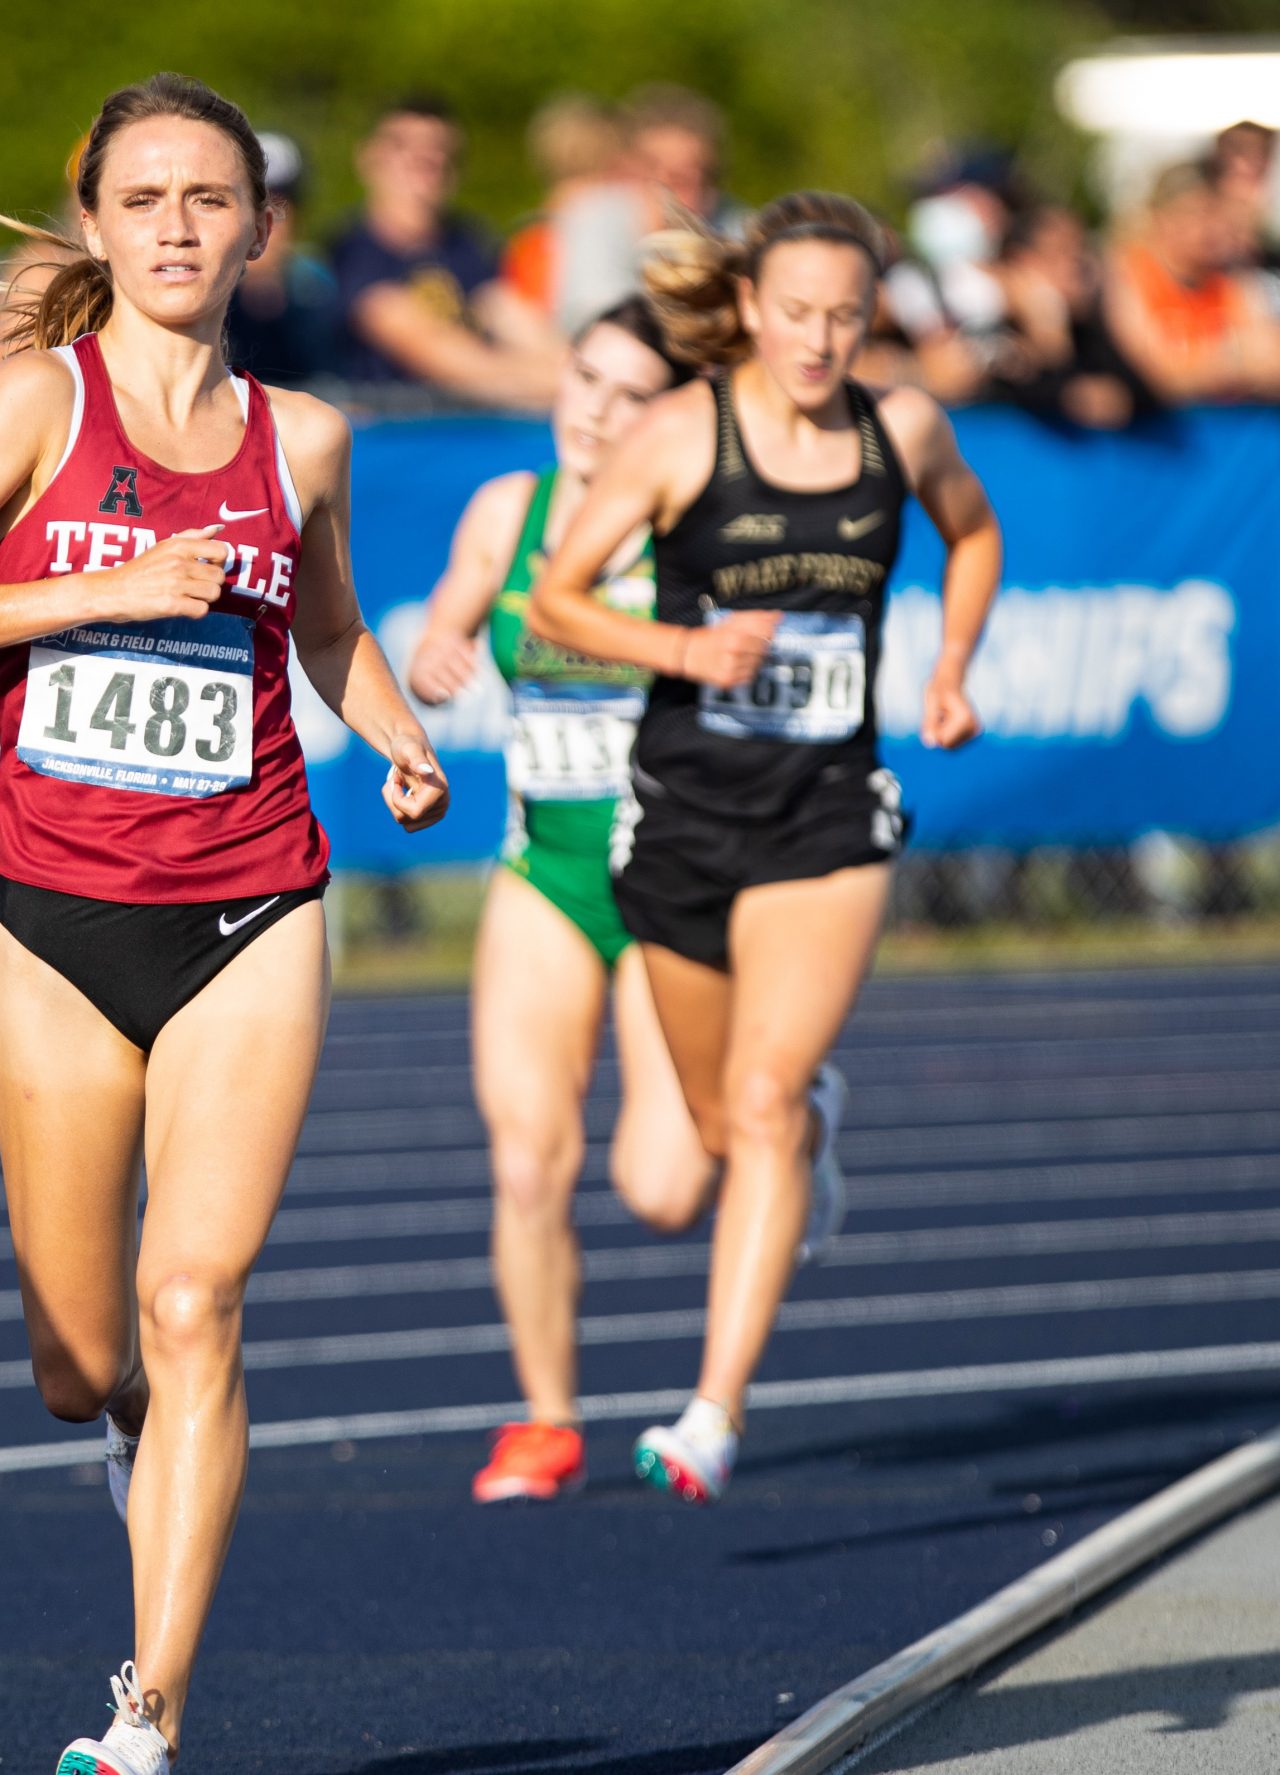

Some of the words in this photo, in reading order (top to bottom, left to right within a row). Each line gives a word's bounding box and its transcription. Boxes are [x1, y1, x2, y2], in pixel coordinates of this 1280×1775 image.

[99, 465, 142, 517] A
[71, 628, 109, 646] TRACK
[110, 633, 120, 647] &
[121, 635, 155, 651] FIELD
[156, 639, 250, 663] CHAMPIONSHIPS
[43, 664, 238, 762] 1483
[42, 758, 114, 780] JACKSONVILLE,
[115, 770, 157, 786] FLORIDA
[172, 776, 196, 790] MAY
